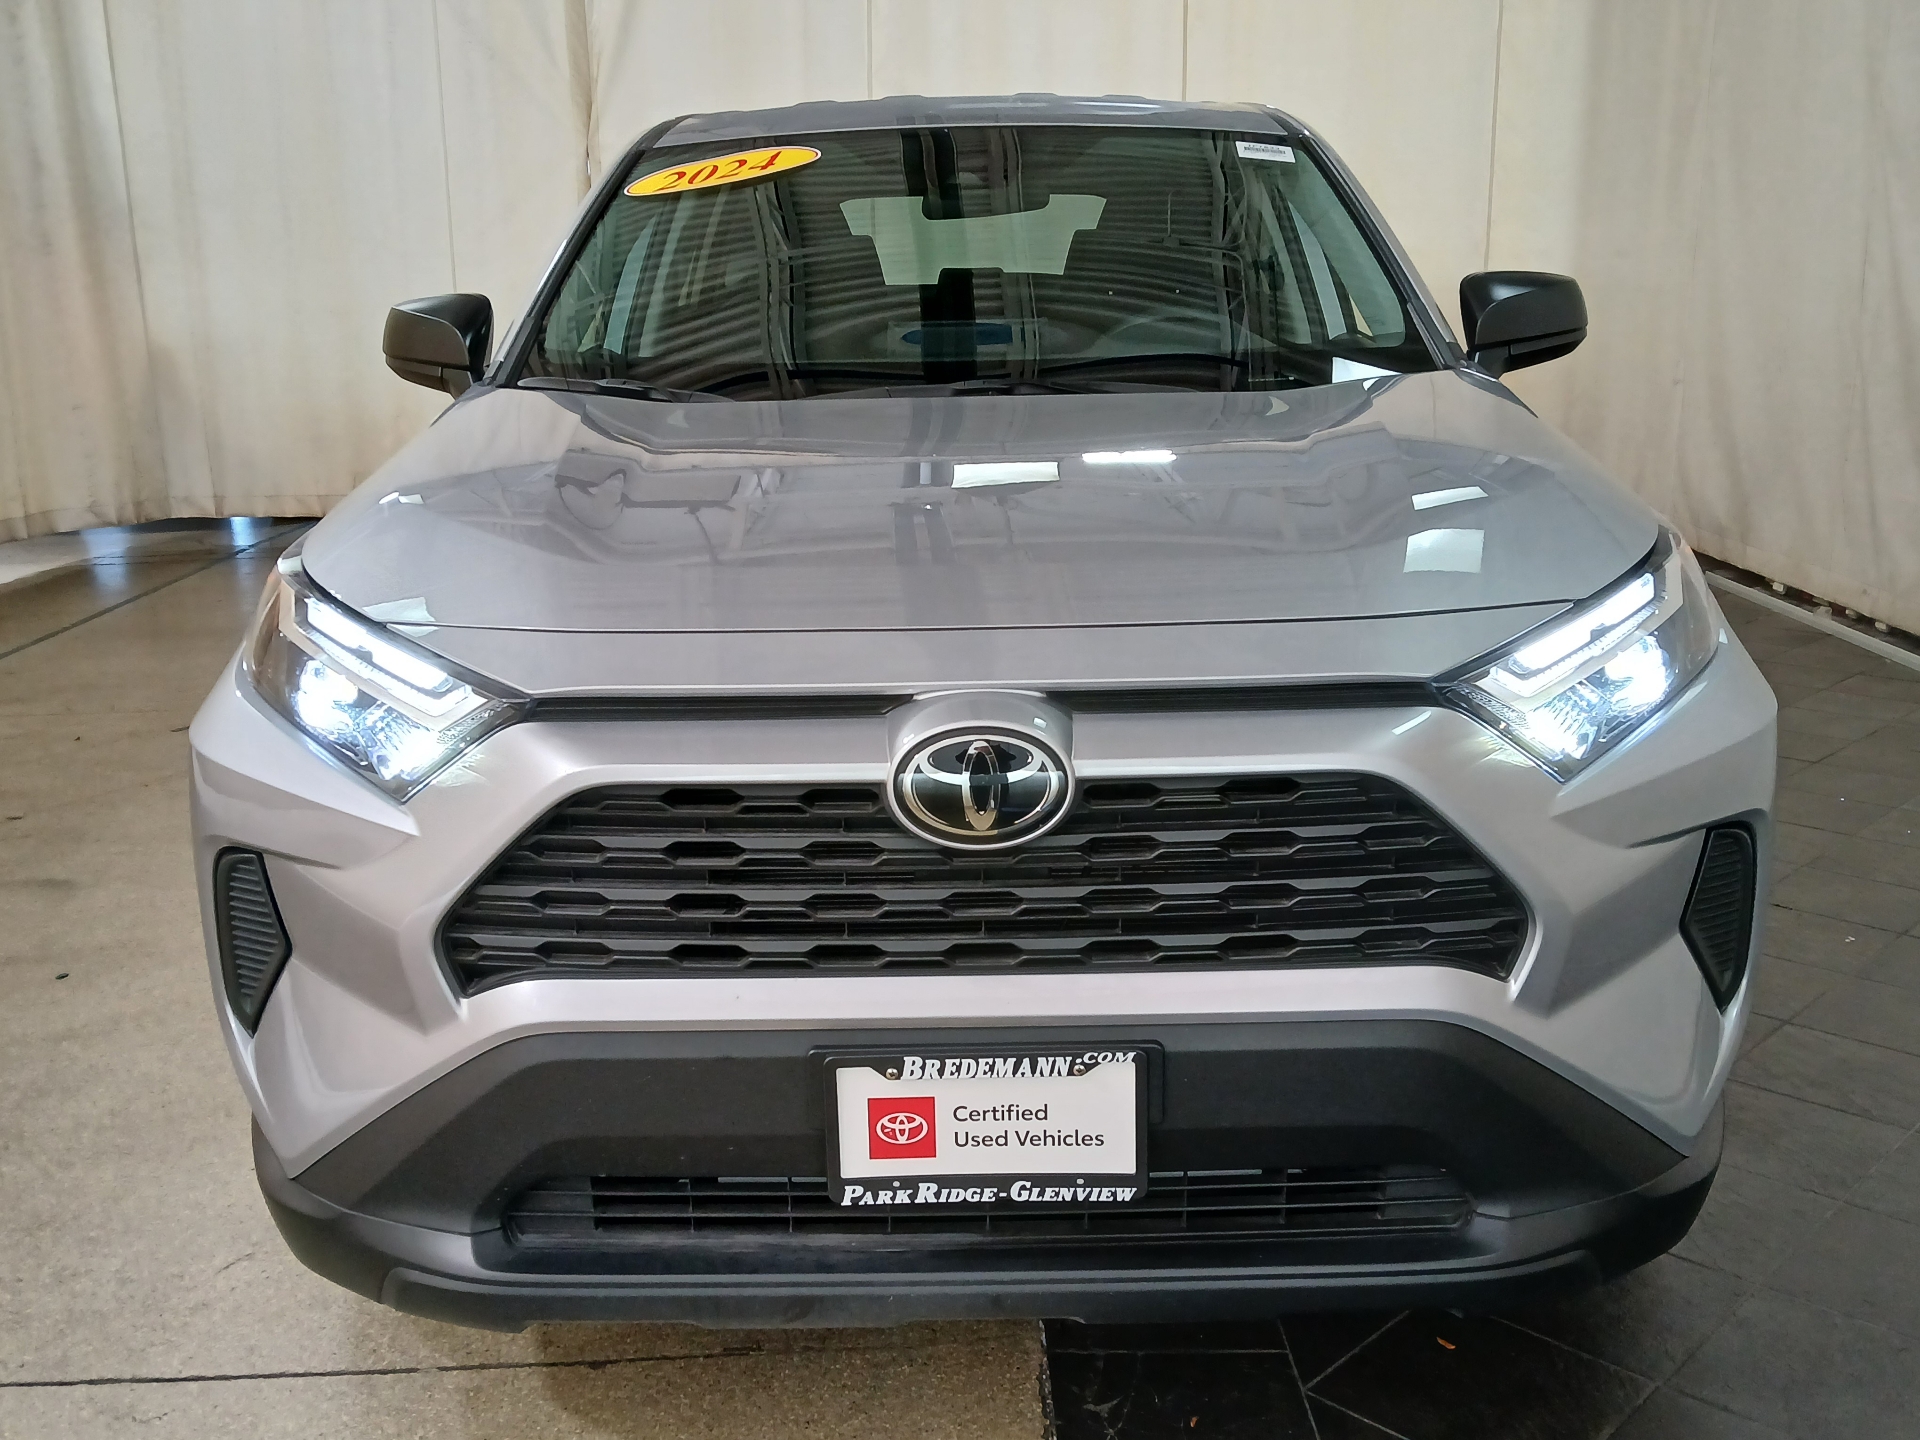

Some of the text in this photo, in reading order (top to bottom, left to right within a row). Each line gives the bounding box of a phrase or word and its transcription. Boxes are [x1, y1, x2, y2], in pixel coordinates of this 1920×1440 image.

[653, 151, 782, 191] 2024
[953, 1104, 1049, 1122] Certified
[953, 1130, 1105, 1148] Used Vehicles
[841, 1184, 914, 1206] PARK
